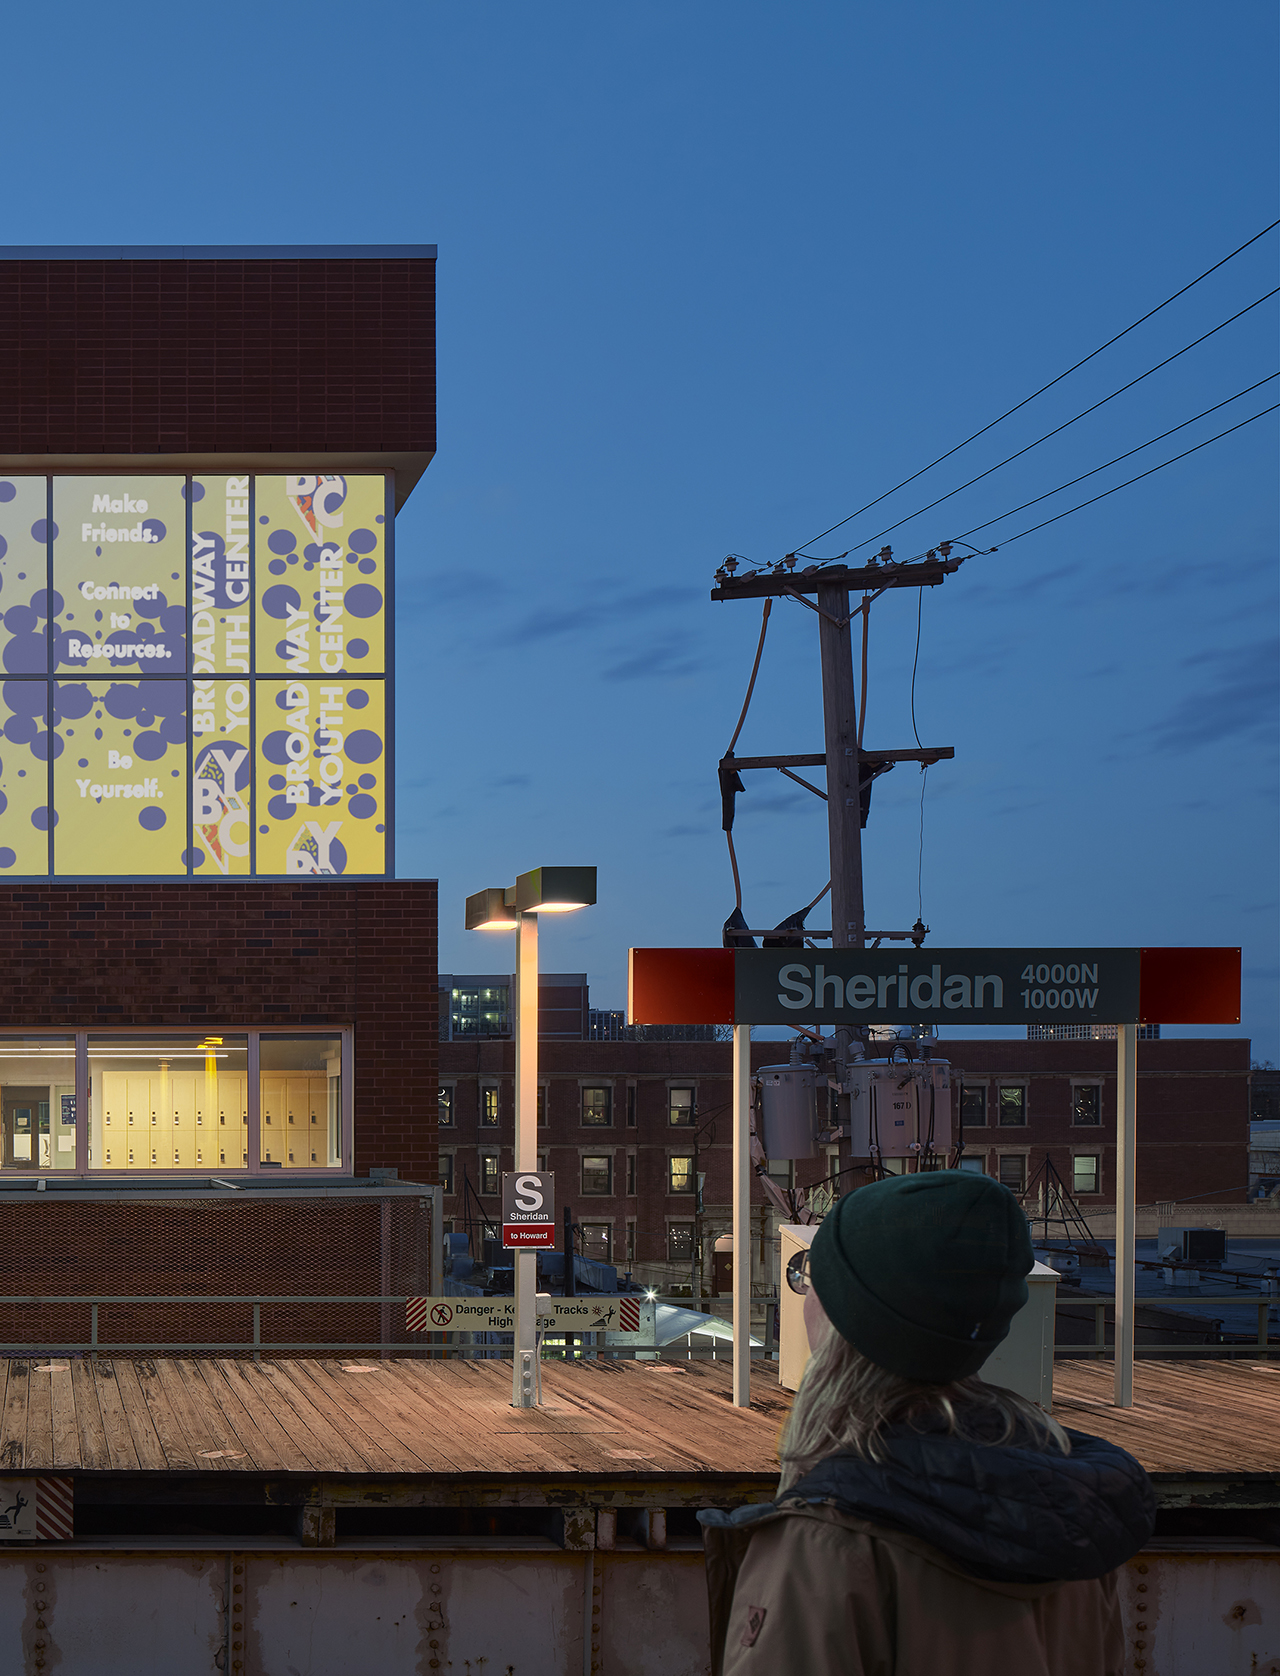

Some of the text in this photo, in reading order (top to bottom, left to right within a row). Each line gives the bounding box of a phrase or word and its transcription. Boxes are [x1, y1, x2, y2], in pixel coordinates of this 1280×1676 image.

[92, 494, 148, 513] Make
[81, 522, 158, 543] Friends.
[81, 580, 160, 600] Connect
[226, 476, 249, 734] YOUTH CENTER
[110, 612, 130, 630] to
[192, 531, 216, 732] BROADWAY
[68, 638, 172, 659] Resources.
[320, 546, 344, 806] YOUTH CENTER
[286, 602, 310, 804] BROADWAY
[108, 750, 133, 770] Be
[76, 778, 164, 799] Yourself.
[777, 963, 1098, 1010] Sheridan 4000N
[1020, 988, 1100, 1009] 1000W
[892, 1102, 904, 1110] 167
[514, 1175, 544, 1212] S
[455, 1304, 495, 1316] Danger
[554, 1305, 589, 1315] Tracks
[488, 1317, 513, 1328] High
